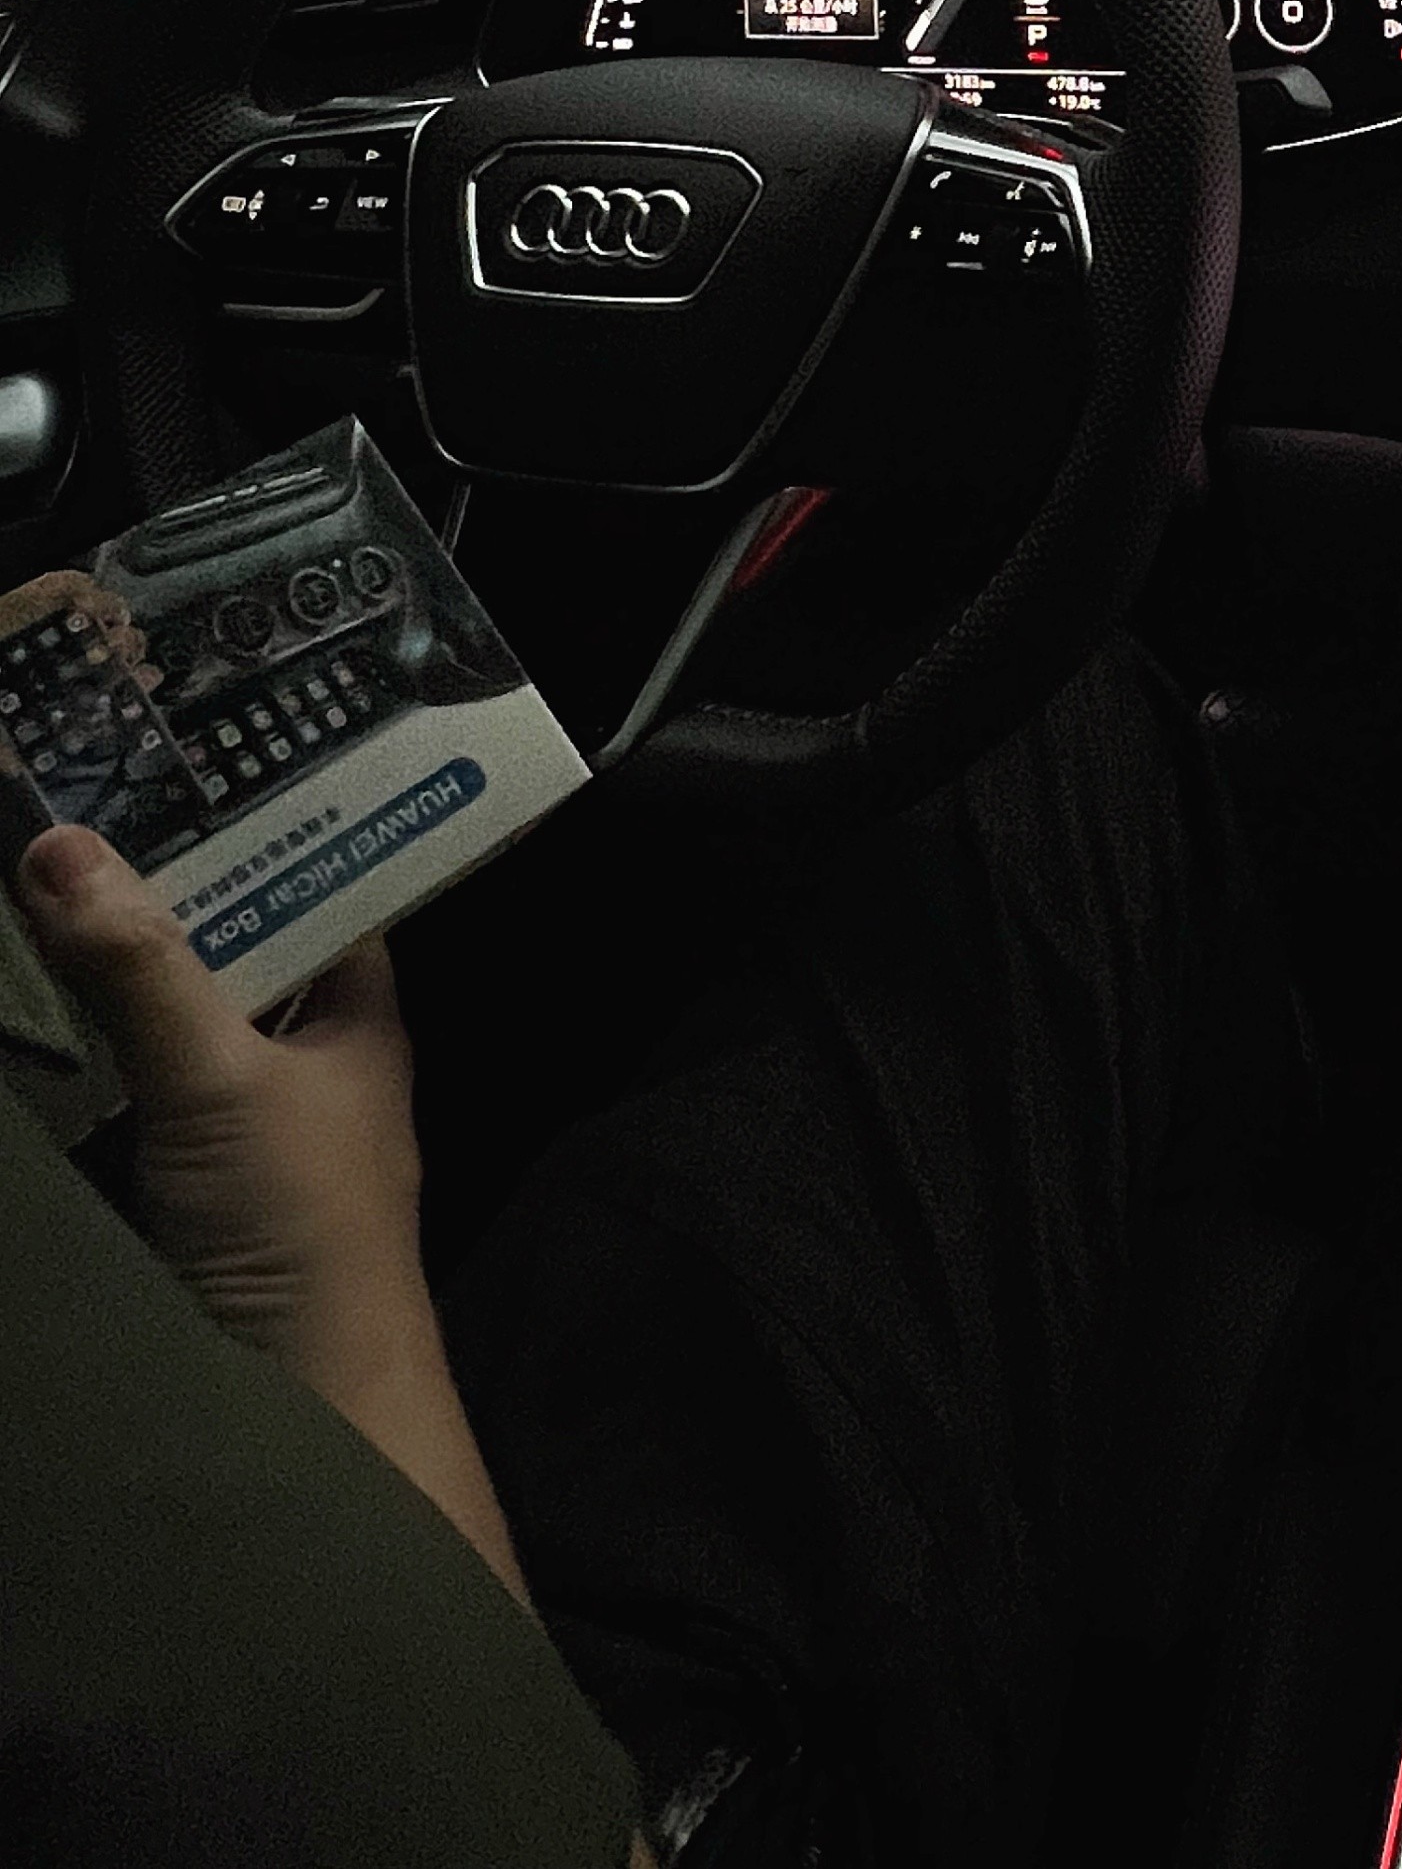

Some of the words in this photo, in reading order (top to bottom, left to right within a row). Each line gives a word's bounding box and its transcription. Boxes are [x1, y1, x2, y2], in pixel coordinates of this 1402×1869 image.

[1027, 24, 1048, 47] P
[352, 774, 464, 862] HUAWEI
[263, 848, 348, 914] HiCar
[204, 905, 266, 954] Box
